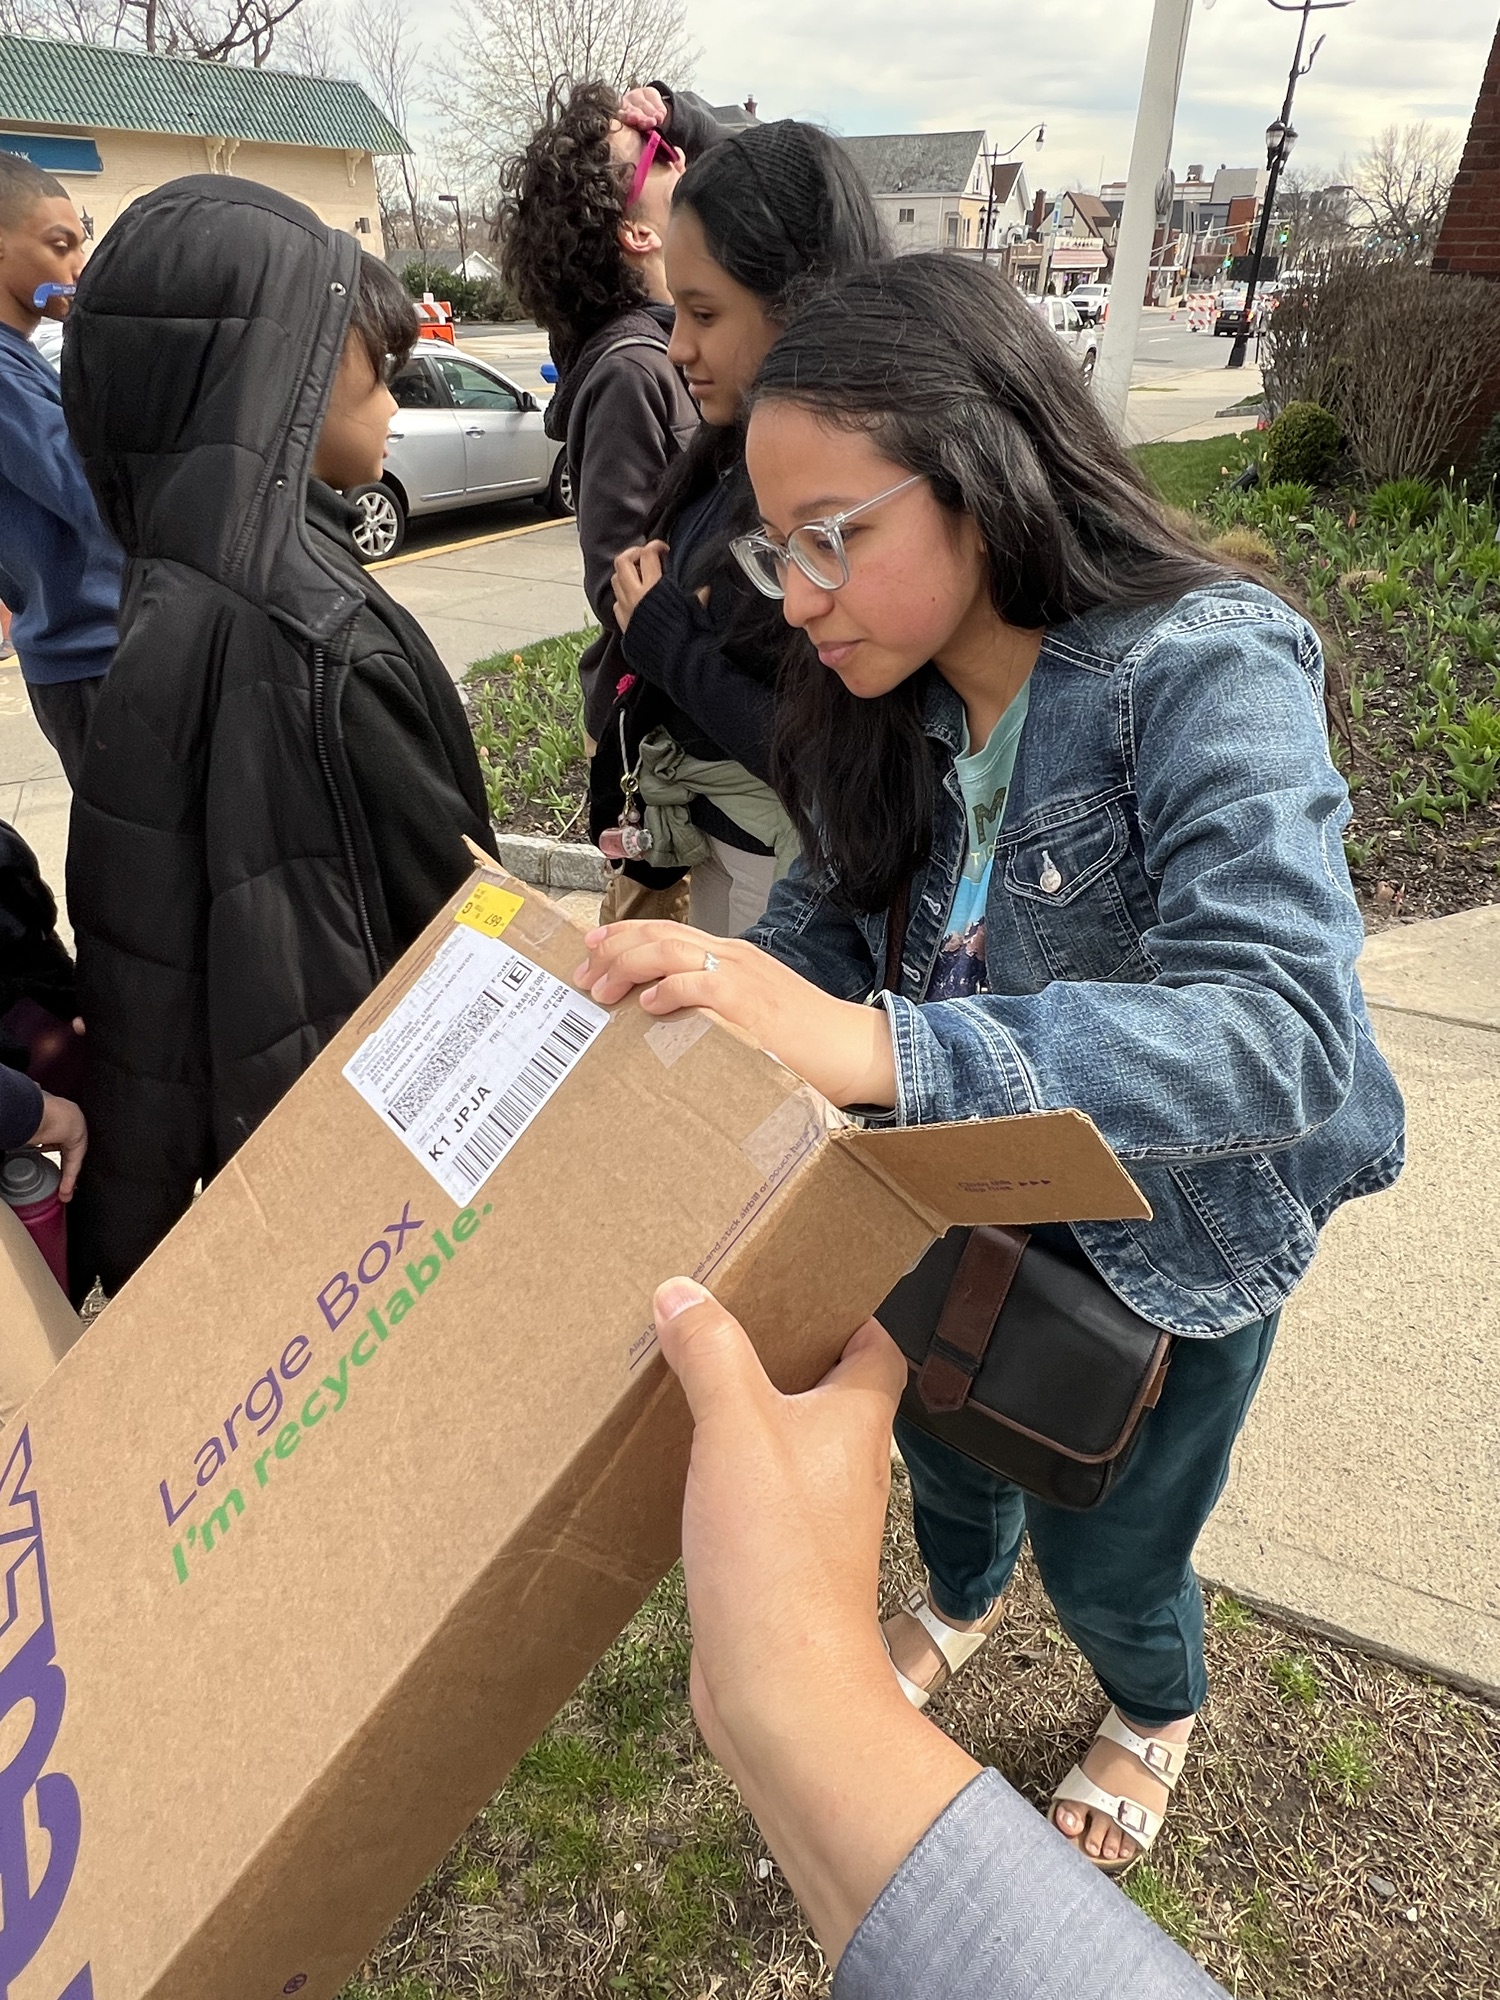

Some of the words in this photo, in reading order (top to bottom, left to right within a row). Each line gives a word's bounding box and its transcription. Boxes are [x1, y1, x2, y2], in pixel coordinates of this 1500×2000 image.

[490, 952, 517, 984] FedEx
[507, 964, 528, 985] E
[487, 1028, 502, 1045] FRI
[506, 1009, 517, 1020] 15
[513, 991, 531, 1010] MAR
[526, 984, 546, 1007] 2DAY
[541, 983, 565, 1011] 07109
[551, 987, 571, 1009] EWR
[368, 1042, 401, 1082] BELLEVILLE
[400, 1017, 422, 1043] PUBLIC
[419, 988, 445, 1018] LIBRARY
[443, 972, 458, 989] AND
[383, 1026, 422, 1072] WASHINGTON
[380, 1051, 416, 1095] BELLEVILLE
[413, 1040, 424, 1053] NJ
[422, 1018, 442, 1042] 07109
[426, 1133, 452, 1163] K1
[448, 1081, 493, 1135] JPJA
[428, 1110, 447, 1134] 7192
[628, 1332, 650, 1357] Align
[740, 1192, 760, 1219] airbill
[760, 1181, 769, 1194] or
[768, 1153, 791, 1184] pouch
[159, 1334, 313, 1527] Large
[316, 1200, 425, 1332] Box
[171, 1489, 245, 1585] I'm
[252, 1203, 494, 1487] recyclable.
